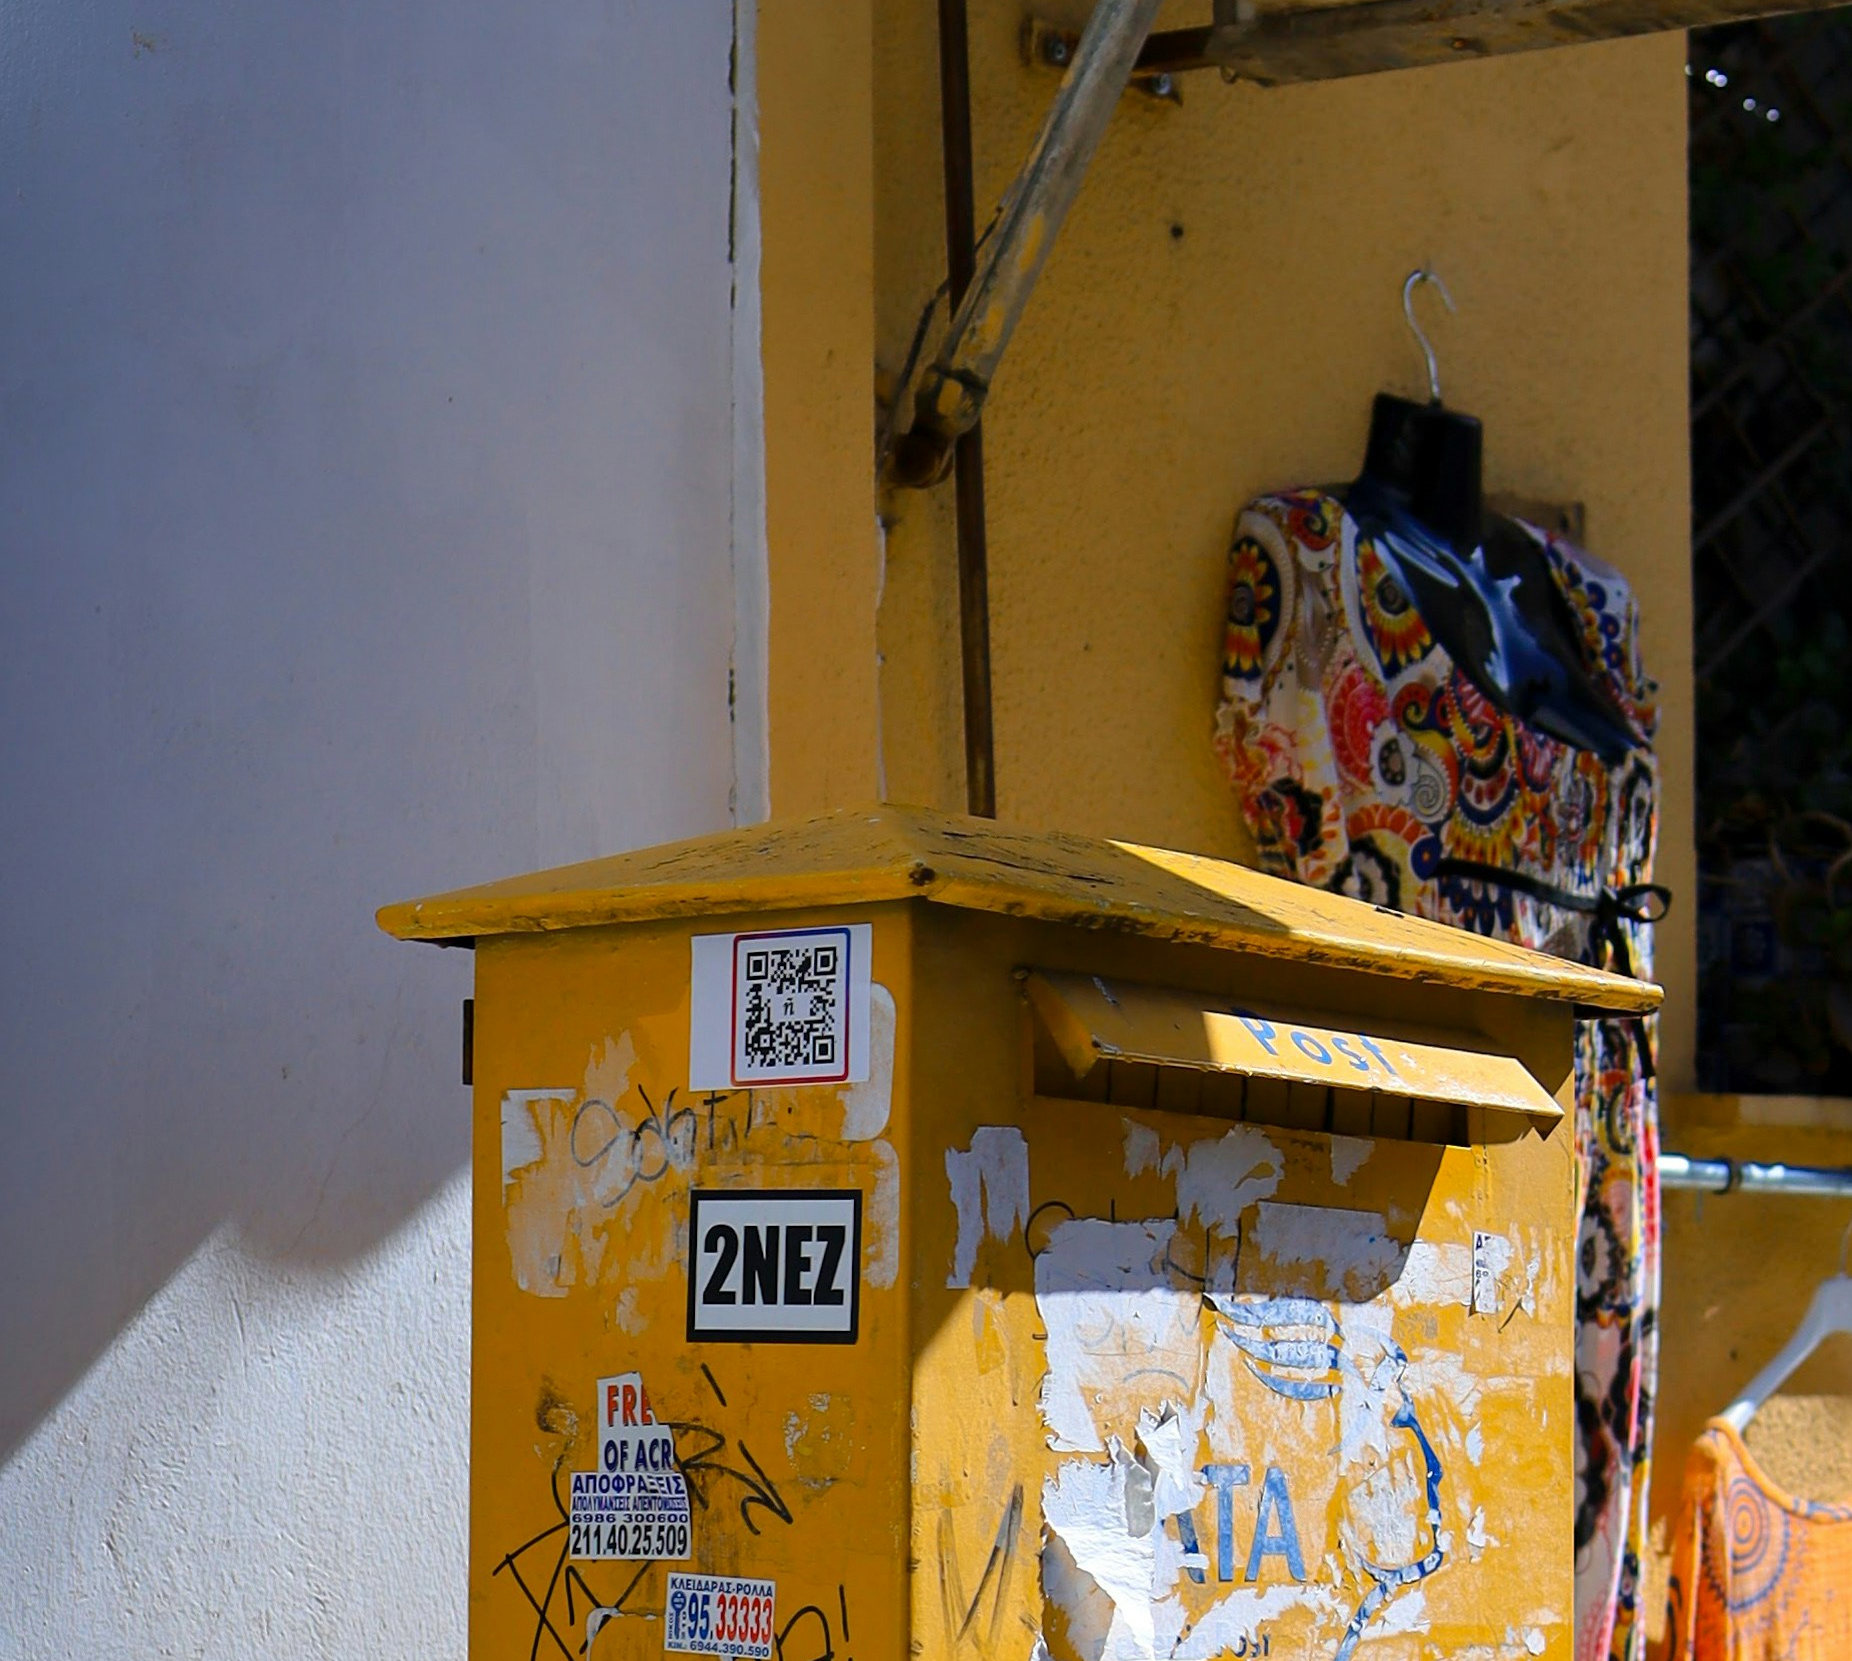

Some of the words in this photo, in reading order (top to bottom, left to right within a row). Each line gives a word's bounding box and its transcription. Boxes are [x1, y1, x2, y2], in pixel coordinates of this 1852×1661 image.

[1230, 1006, 1397, 1073] Post
[702, 1223, 846, 1307] 2NEZ
[604, 1439, 629, 1472] OF
[572, 1513, 617, 1524] 6986
[622, 1513, 689, 1524] 300600
[571, 1524, 688, 1557] 211.40.25.509
[690, 1640, 769, 1658] 6944.390.590
